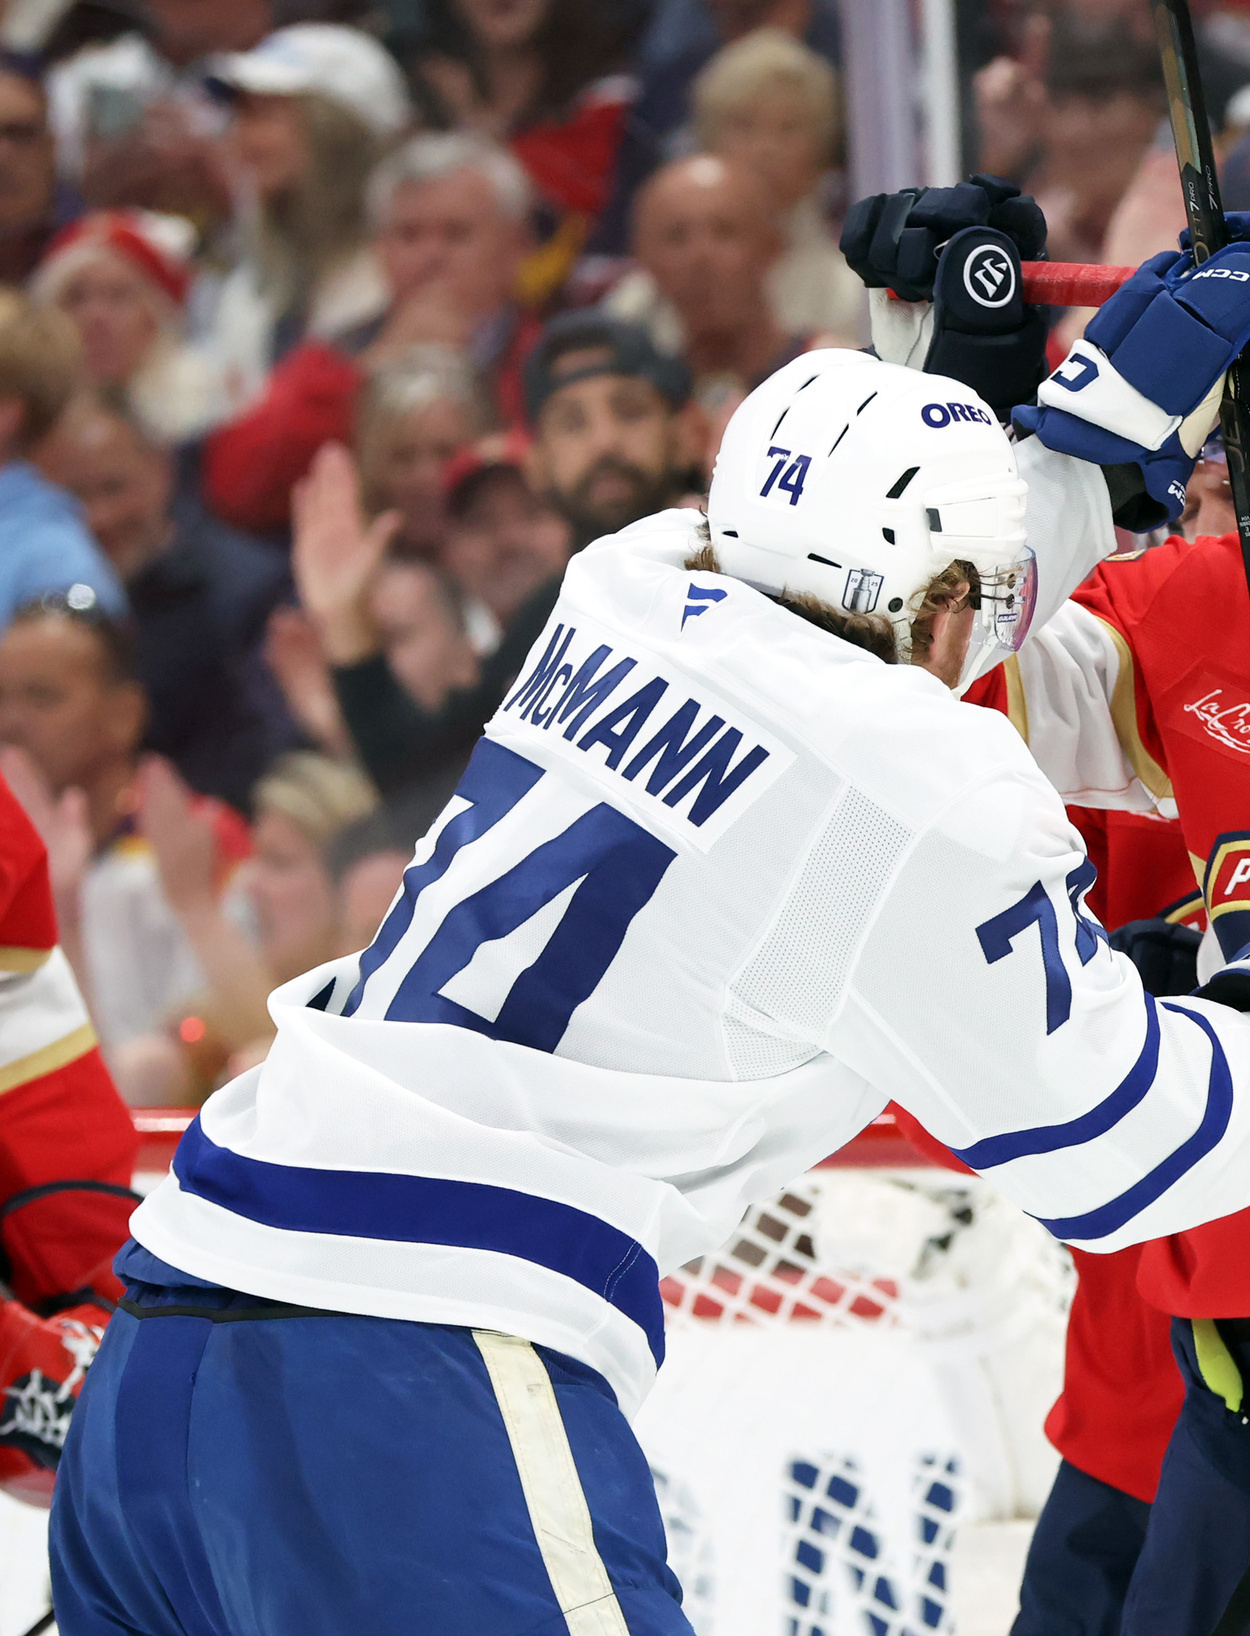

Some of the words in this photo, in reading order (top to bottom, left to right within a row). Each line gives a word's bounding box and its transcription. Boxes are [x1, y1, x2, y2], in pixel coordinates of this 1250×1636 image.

[1192, 268, 1250, 282] CCM
[921, 402, 992, 428] OREO
[759, 446, 813, 506] 74
[504, 623, 770, 827] McMANN
[339, 736, 678, 1054] 74
[975, 855, 1113, 1036] 74
